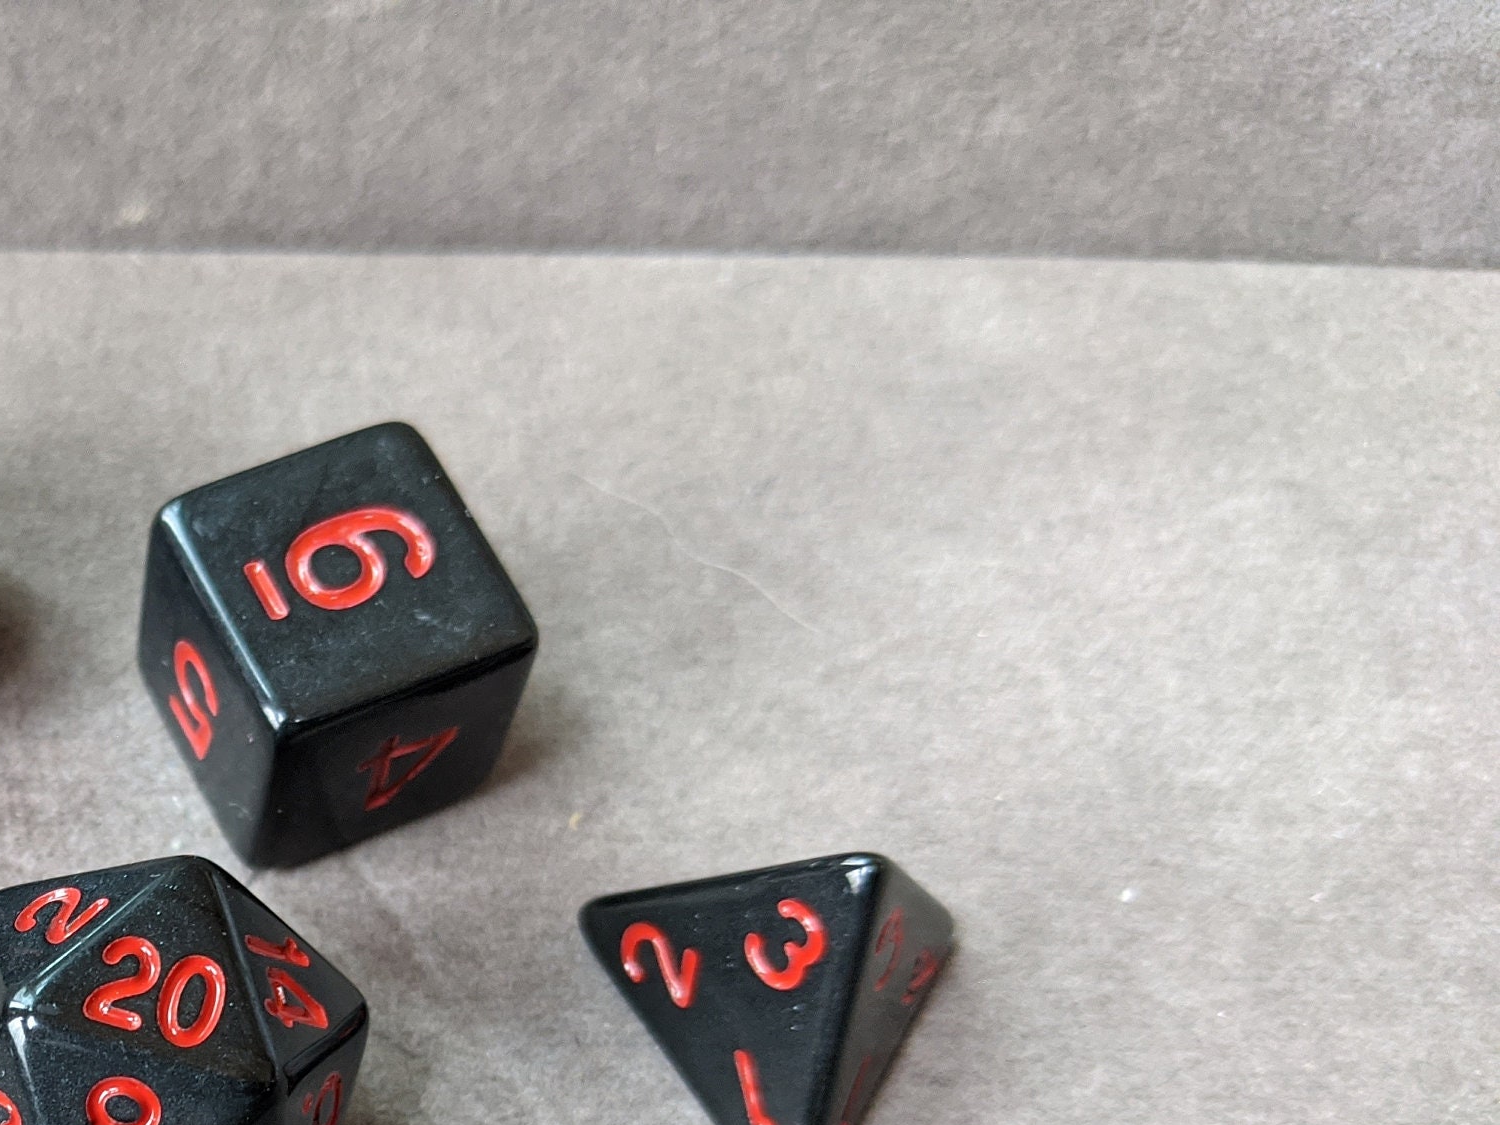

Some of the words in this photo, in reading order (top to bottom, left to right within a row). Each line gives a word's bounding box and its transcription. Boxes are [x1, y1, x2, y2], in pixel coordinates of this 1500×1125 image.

[168, 639, 221, 762] 5
[357, 726, 460, 812] 4
[13, 886, 111, 946] 2
[743, 897, 829, 992] 3
[81, 934, 228, 1050] 20
[244, 934, 331, 1031] 14
[619, 920, 703, 1010] 2
